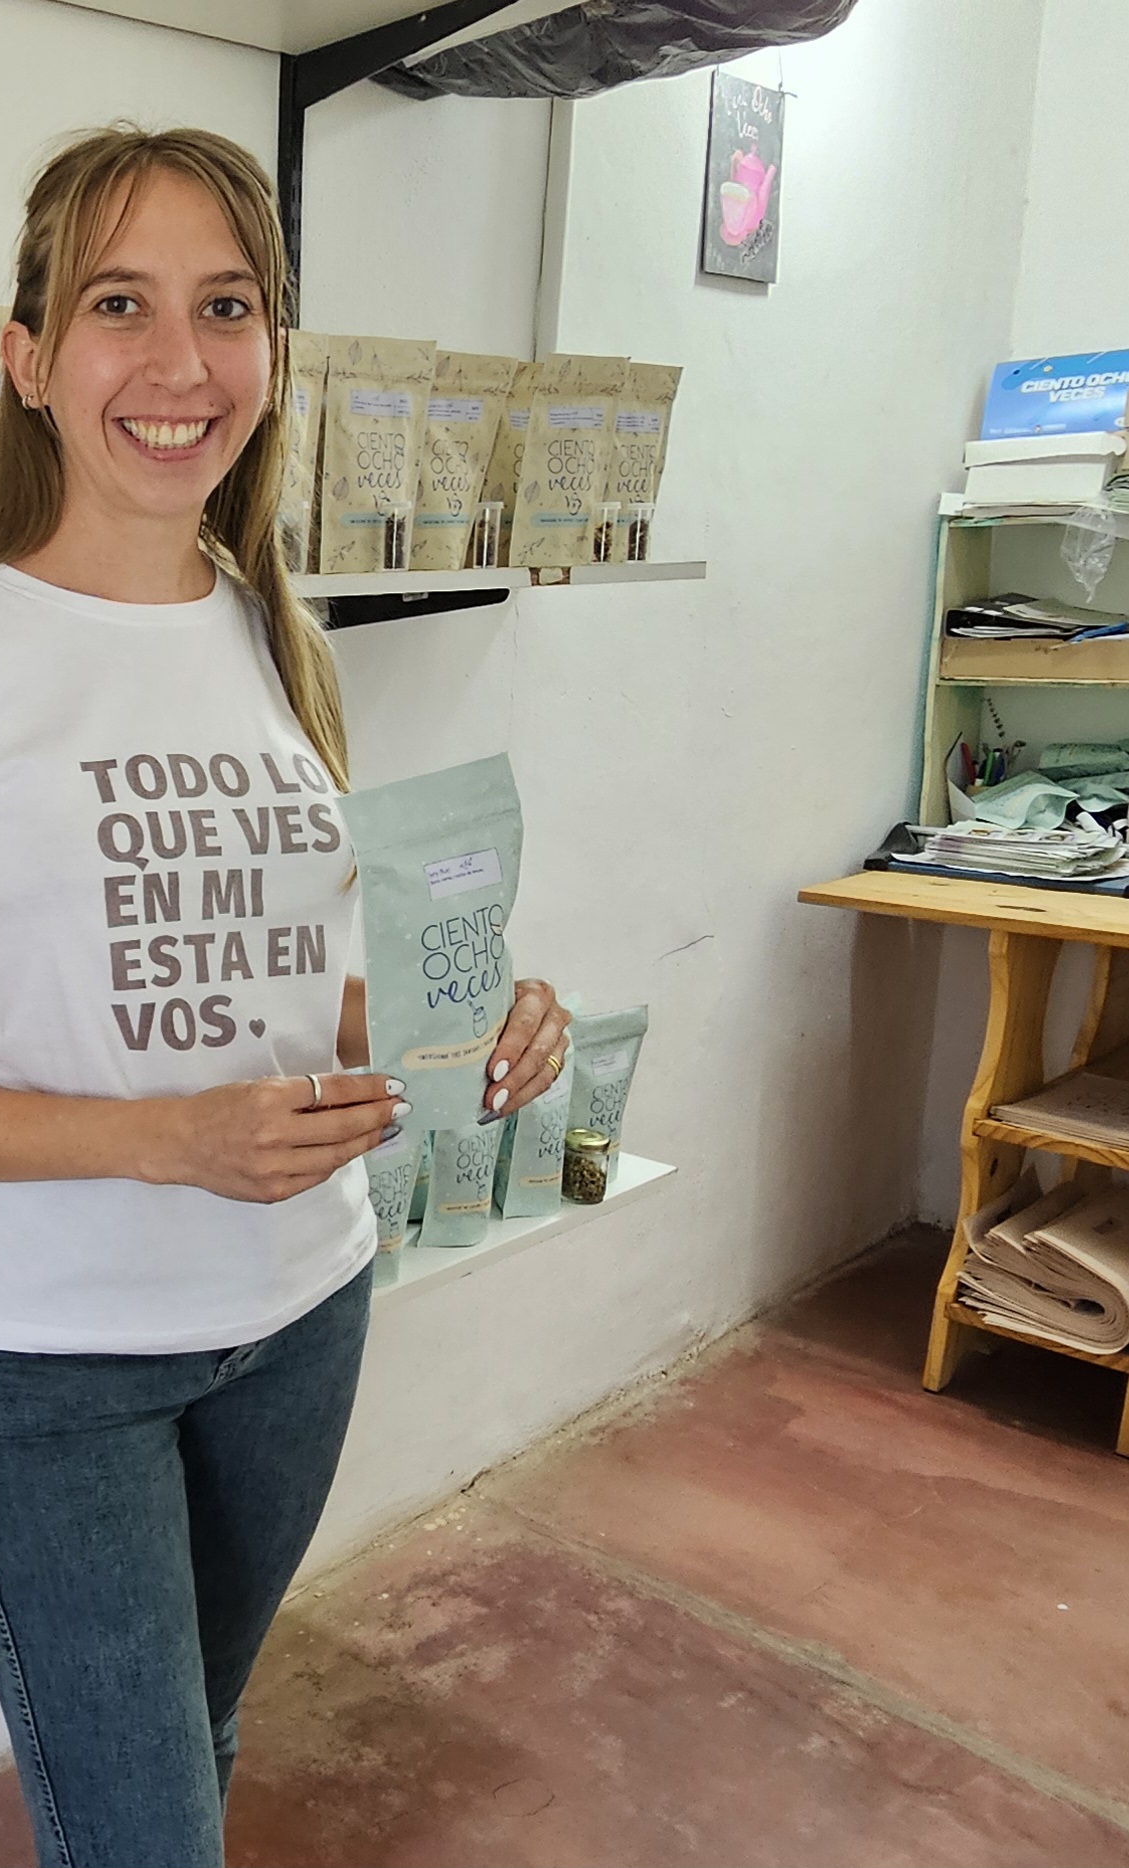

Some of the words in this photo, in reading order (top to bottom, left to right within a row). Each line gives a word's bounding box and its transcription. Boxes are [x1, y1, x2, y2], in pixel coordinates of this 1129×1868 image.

[1021, 375, 1085, 394] CIENTO
[1048, 386, 1107, 403] VECES
[357, 432, 406, 450] CIENTO
[357, 450, 405, 471] OCHO
[357, 472, 402, 489] veces
[617, 479, 651, 493] vece
[79, 752, 251, 804] TODO
[261, 752, 329, 795] LO
[96, 808, 223, 872] QUE
[232, 803, 342, 857] VES
[102, 869, 182, 929] EN
[202, 867, 264, 921] MI
[421, 904, 504, 951] CIENTO
[109, 930, 254, 992] ESTA
[267, 924, 327, 978] EN
[422, 934, 505, 980] OCHO
[427, 961, 502, 1009] veces
[111, 994, 238, 1052] VOS
[589, 1110, 620, 1128] vece
[456, 1150, 494, 1169] OCH
[456, 1165, 491, 1184] vece
